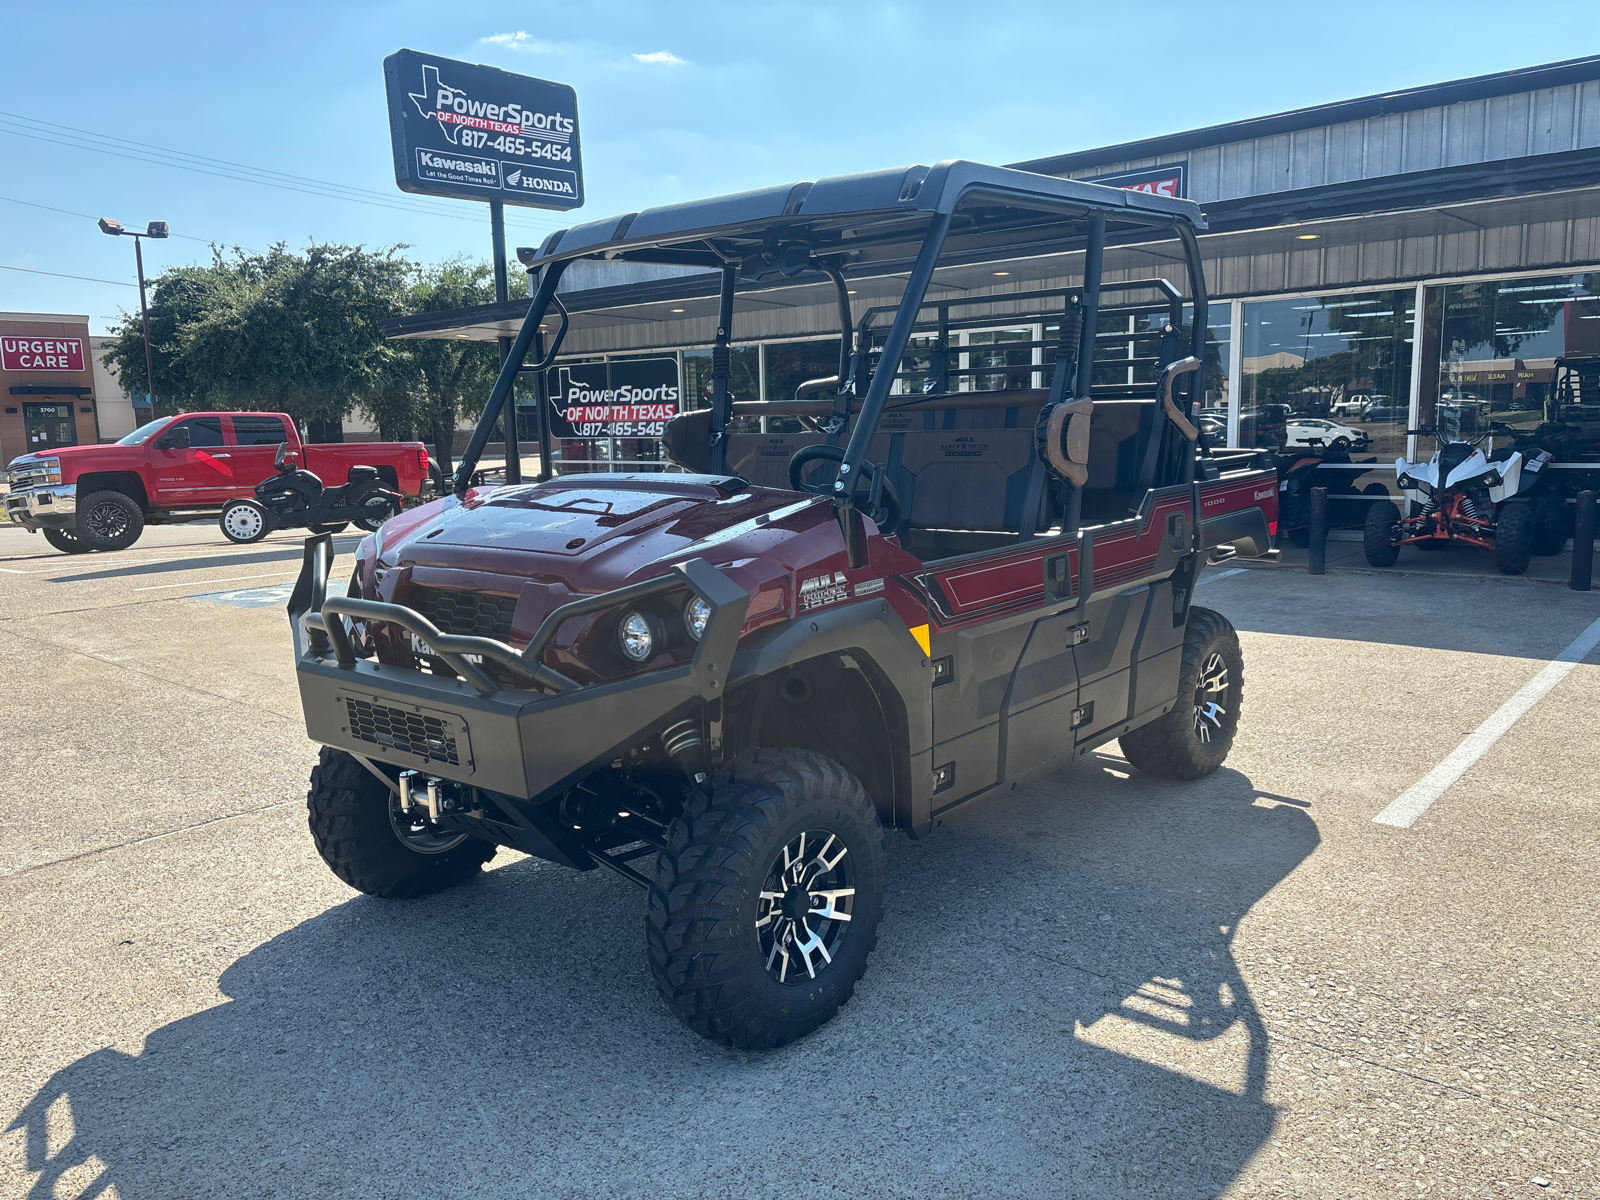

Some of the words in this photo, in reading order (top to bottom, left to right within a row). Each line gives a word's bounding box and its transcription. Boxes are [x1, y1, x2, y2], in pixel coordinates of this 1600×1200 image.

[436, 89, 574, 133] PowerSports
[437, 111, 451, 121] OF
[453, 114, 488, 129] NORTH
[489, 120, 520, 135] TEXAS
[461, 129, 572, 162] 817-465-5454
[420, 152, 496, 176] Kawasaki
[437, 171, 447, 179] the
[448, 173, 464, 181] Good
[465, 175, 482, 183] Times
[522, 176, 574, 194] HONDA
[5, 340, 79, 354] URGENT
[20, 355, 69, 368] CARE
[567, 383, 678, 404] PowerSports
[567, 407, 583, 421] OF
[631, 404, 674, 419] TEXAS
[582, 421, 665, 436] 817-465-545
[1204, 498, 1225, 507] 1000
[1253, 488, 1275, 500] Kawasaki
